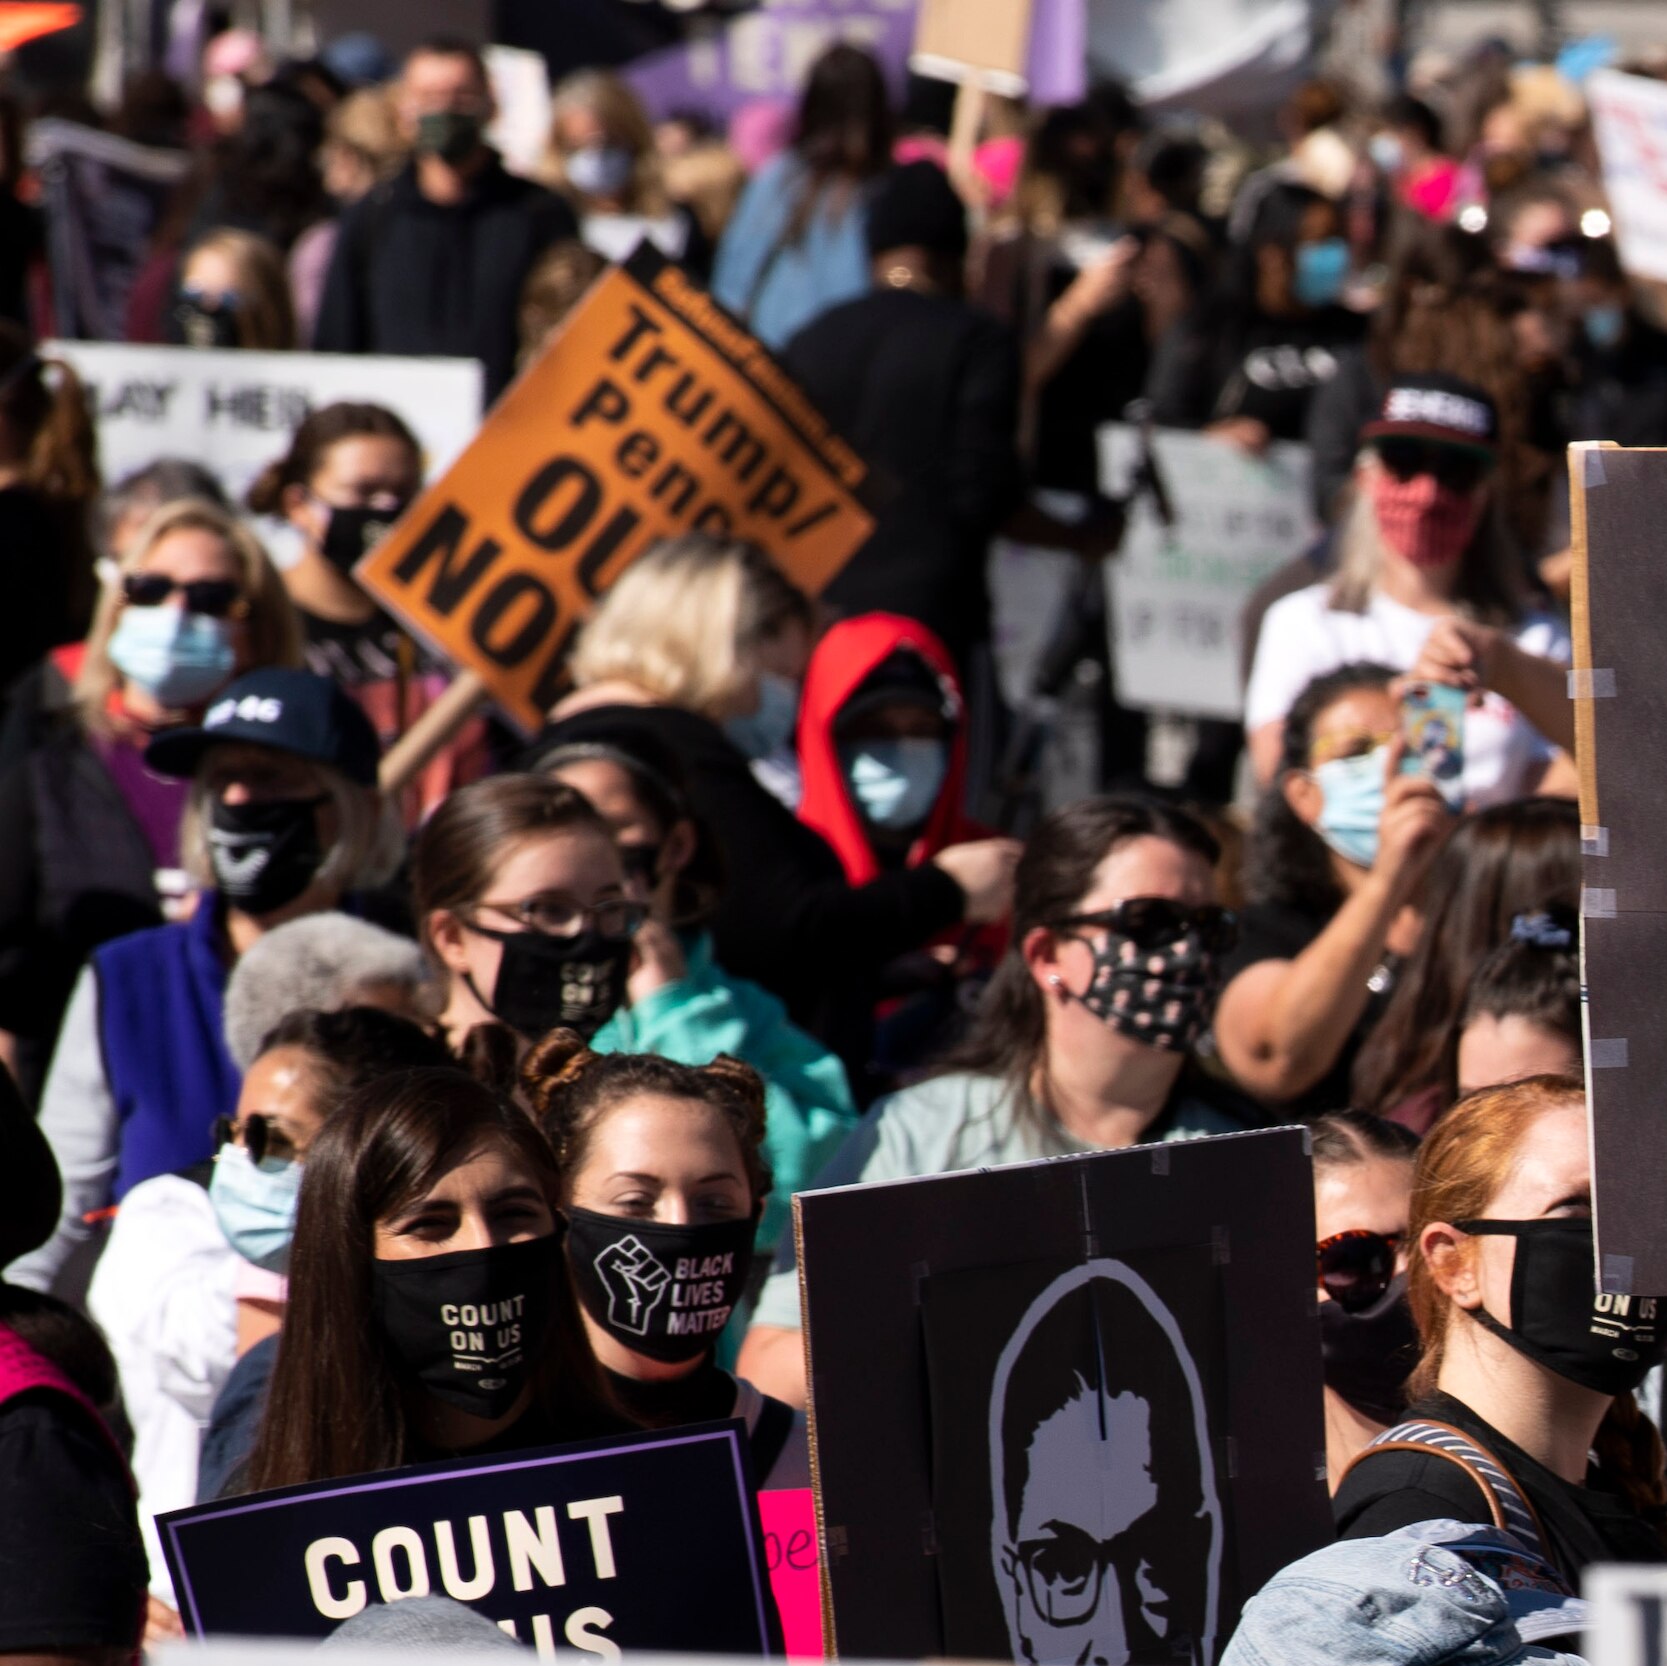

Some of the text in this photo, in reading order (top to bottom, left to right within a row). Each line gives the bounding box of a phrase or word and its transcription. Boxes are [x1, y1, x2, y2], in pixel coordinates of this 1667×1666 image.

[606, 303, 840, 541] Trump/
[569, 378, 733, 535] Penc
[512, 454, 643, 600] OU
[392, 504, 580, 705] NO
[675, 1252, 734, 1280] BLACK
[671, 1280, 725, 1307] LIVES
[1594, 1293, 1657, 1319] ON US
[441, 1294, 525, 1326] COUNT
[666, 1305, 731, 1335] MATTER
[450, 1323, 520, 1351] ON US
[305, 1495, 624, 1620] COUNT
